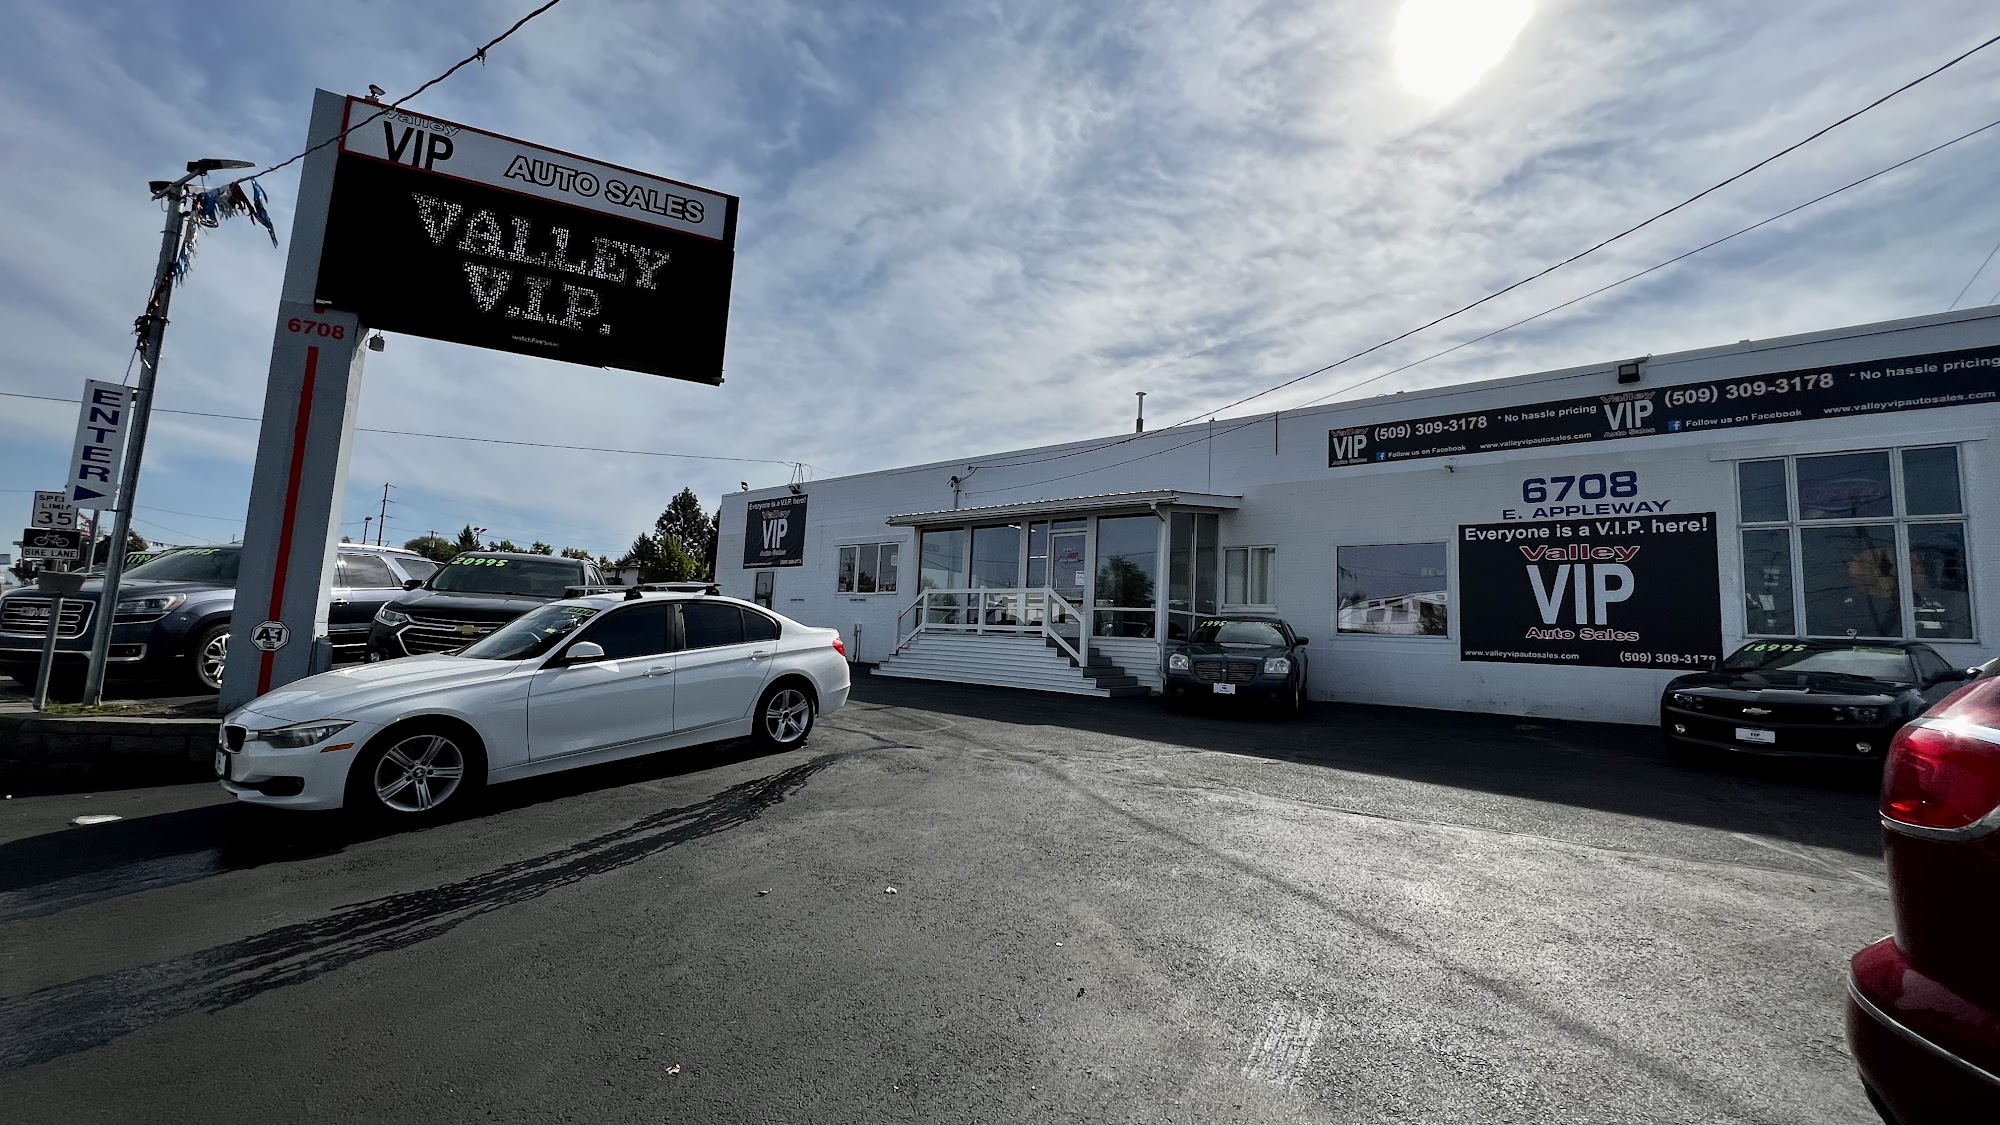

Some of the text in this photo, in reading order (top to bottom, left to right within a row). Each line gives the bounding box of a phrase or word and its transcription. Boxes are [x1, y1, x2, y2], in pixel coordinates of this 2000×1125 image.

[384, 121, 454, 171] VIP
[504, 154, 705, 224] AUTO SALES
[411, 191, 673, 290] VALLEY
[287, 318, 345, 340] 6708
[1886, 364, 1938, 377] hassle
[1943, 357, 2000, 373] pricing
[1600, 391, 1656, 404] Valley
[1664, 372, 1834, 408] (509) 309-3178
[1823, 390, 1996, 414] www.valleyvipautosales.com
[1521, 409, 1555, 421] hassle
[1558, 405, 1597, 418] pricing
[1604, 400, 1653, 431] VIP
[1686, 417, 1718, 428] Follow
[1721, 416, 1732, 424] us
[1751, 409, 1802, 421] Facebook
[78, 388, 123, 483] ENTER
[1374, 415, 1488, 441] (509) 309-3178
[1333, 434, 1367, 459] VIP
[1480, 432, 1592, 450] www.valleyvipautosales.com
[1388, 450, 1410, 458] Follow
[1432, 445, 1466, 454] Facebook
[1522, 470, 1638, 504] 6708
[39, 494, 66, 503] SPE
[37, 511, 72, 526] 35
[1502, 499, 1671, 520] E. APPLEWAY
[763, 518, 788, 549] VIP
[1465, 517, 1708, 543] Everyone is a V.I.P. here!
[25, 548, 77, 558] BIKE LANE
[451, 556, 508, 567] 20995
[1519, 543, 1641, 562] Valley
[1526, 563, 1635, 625] VIP
[1525, 626, 1640, 642] Auto Sales
[1464, 649, 1580, 661] www.valleyvipautosales.com
[1620, 651, 1651, 664] (509)
[1744, 643, 1807, 652] 16995
